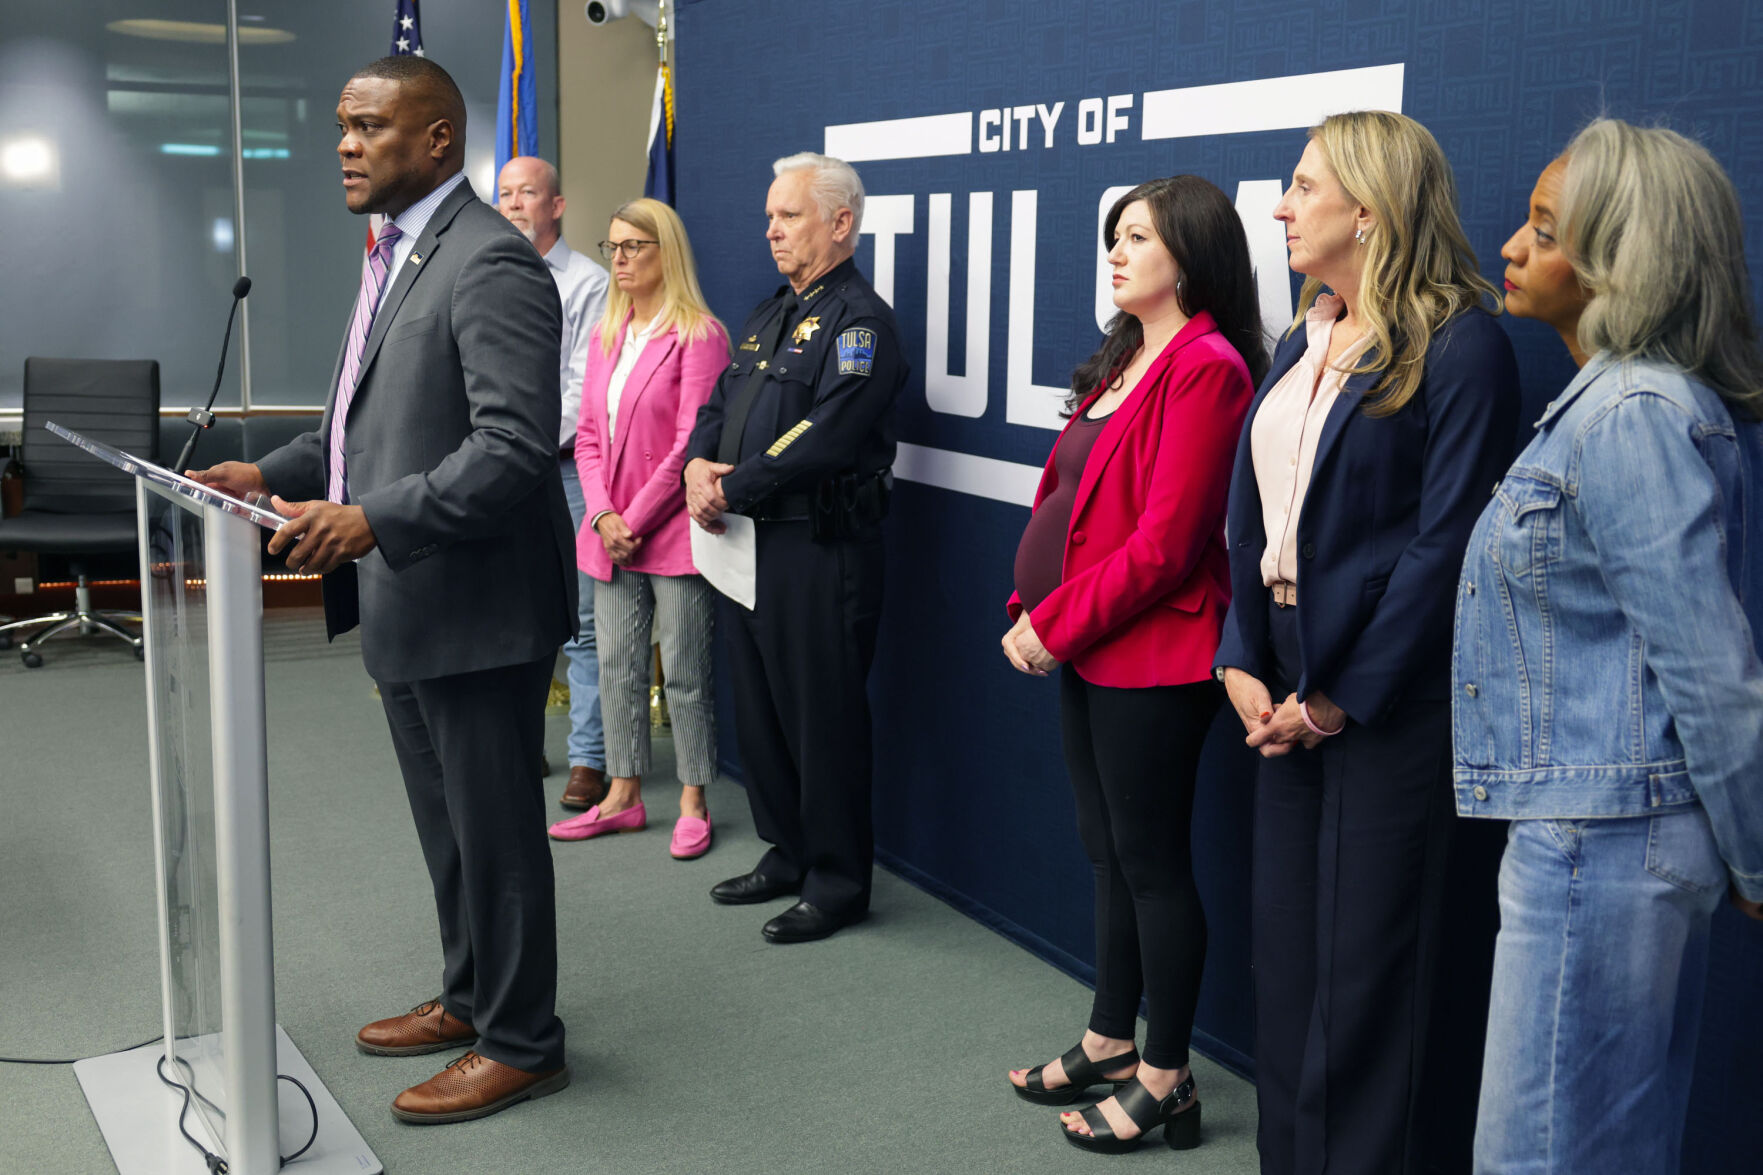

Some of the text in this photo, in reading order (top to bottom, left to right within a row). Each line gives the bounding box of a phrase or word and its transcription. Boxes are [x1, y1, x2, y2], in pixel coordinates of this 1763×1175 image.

[979, 93, 1134, 153] CITY OF
[858, 179, 1294, 431] TULA
[841, 330, 872, 349] TULSA
[841, 360, 869, 373] POLICE
